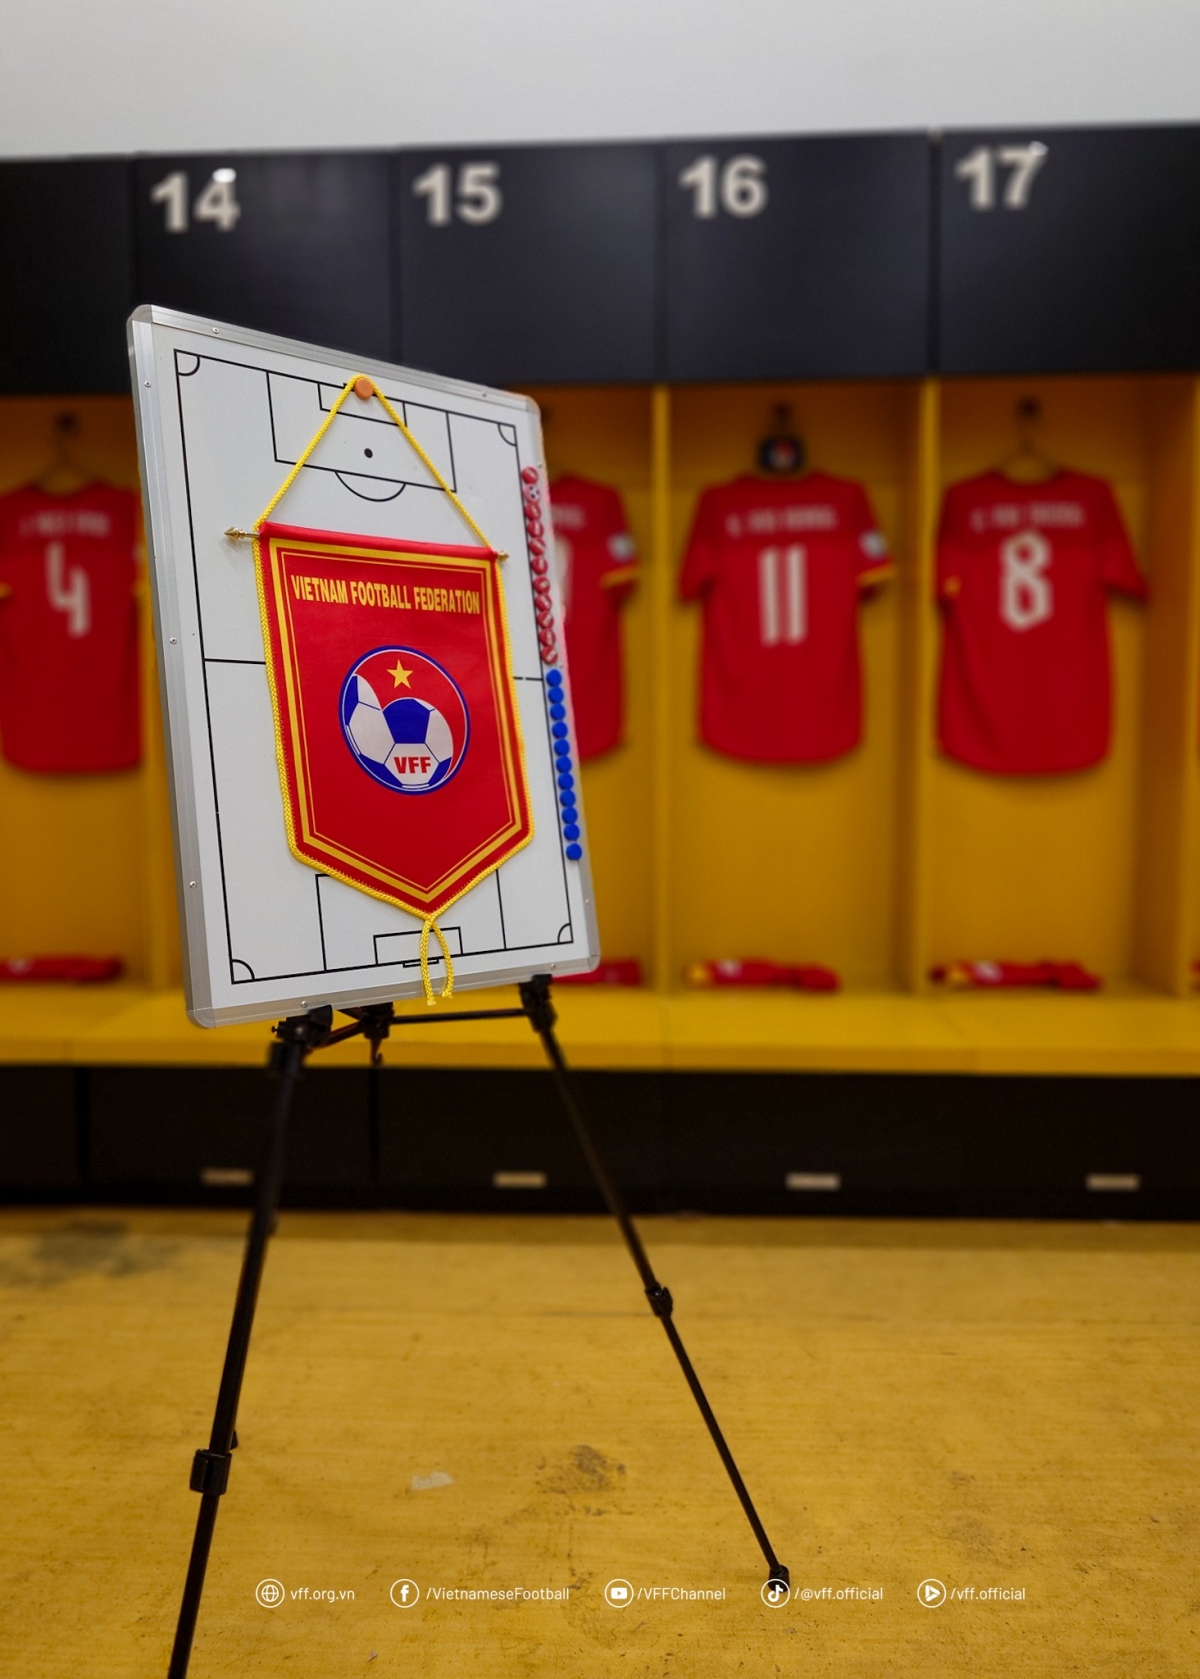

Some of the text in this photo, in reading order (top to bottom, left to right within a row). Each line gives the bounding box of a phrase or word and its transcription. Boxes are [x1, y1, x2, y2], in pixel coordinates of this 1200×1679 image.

[152, 169, 240, 233] 14
[413, 162, 502, 226] 15
[680, 153, 767, 219] 16
[955, 141, 1048, 210] 17
[45, 541, 92, 638] 4
[291, 575, 480, 614] VIETNAM FOOTBALL FEDERATION
[758, 542, 809, 646] 11
[1000, 528, 1053, 633] 8
[393, 756, 431, 774] VFF
